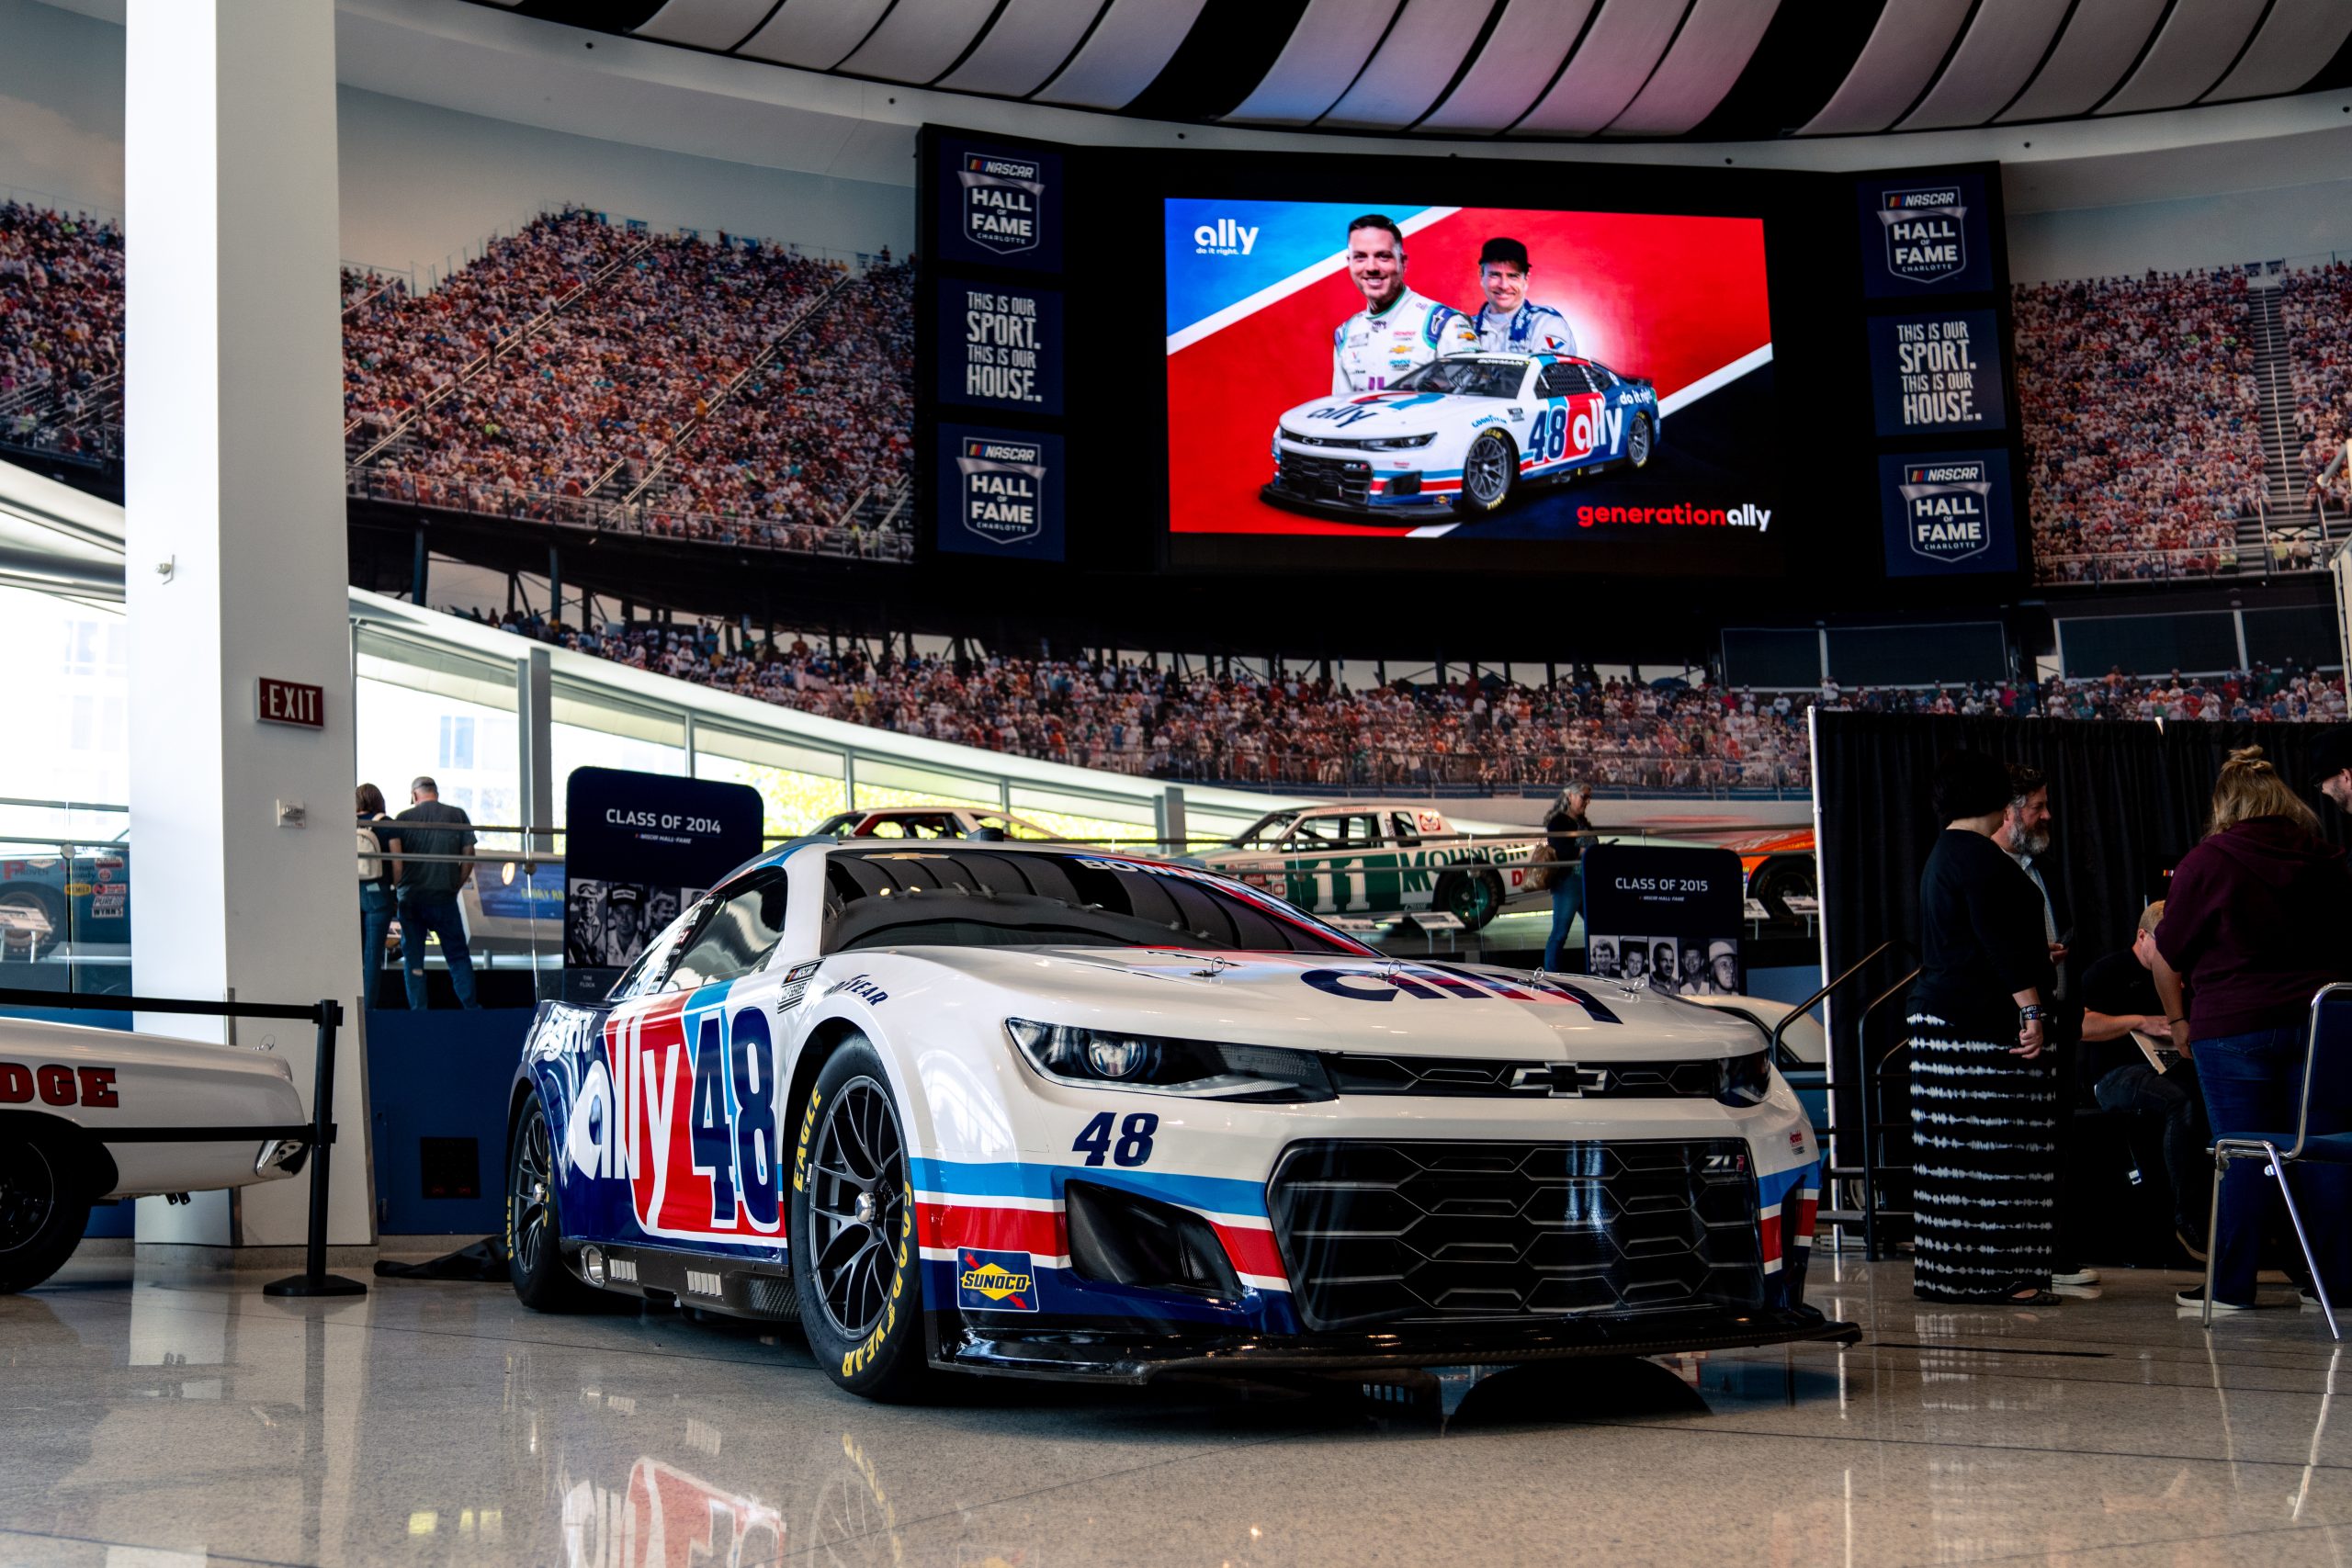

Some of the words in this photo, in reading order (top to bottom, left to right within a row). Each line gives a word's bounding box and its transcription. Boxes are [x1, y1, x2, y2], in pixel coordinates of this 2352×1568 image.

[985, 161, 1035, 178] NASCAR
[972, 187, 1033, 212] HALL
[1905, 192, 1955, 207] NASCAR
[971, 213, 1033, 238] FAME
[1194, 219, 1260, 255] ally
[1894, 220, 1956, 241] HALL
[977, 232, 1026, 245] CHARLOTTE
[1894, 244, 1959, 265] FAME
[1902, 263, 1952, 273] CHARLOTTE
[967, 291, 994, 311] THIS
[997, 295, 1010, 313] IS
[1011, 297, 1037, 317] OUR
[967, 310, 1042, 350] SPORT.
[1896, 323, 1925, 343] THIS
[1928, 322, 1940, 340] IS
[1942, 321, 1970, 339] OUR
[967, 344, 994, 364] THIS
[997, 347, 1010, 366] IS
[1011, 349, 1037, 369] OUR
[1898, 338, 1977, 374] SPORT.
[967, 363, 1043, 402] HOUSE.
[1901, 374, 1929, 393] THIS
[1932, 373, 1945, 390] IS
[1947, 371, 1974, 389] OUR
[1306, 404, 1378, 428] ally
[1903, 389, 1983, 425] HOUSE.
[1527, 405, 1568, 465] 48
[1572, 398, 1623, 456] ally
[985, 445, 1036, 462] NASCAR
[971, 474, 1035, 498] HALL
[1928, 467, 1979, 481] NASCAR
[971, 500, 1035, 525] FAME
[1916, 497, 1980, 517] HALL
[977, 521, 1027, 533] CHARLOTTE
[1917, 521, 1982, 542] FAME
[1924, 541, 1976, 550] CHARLOTTE
[268, 683, 317, 722] EXIT
[605, 808, 657, 828] CLASS
[661, 814, 682, 829] OF
[685, 816, 722, 834] 2014
[1312, 857, 1371, 913] 11
[1615, 877, 1656, 890] CLASS
[1659, 878, 1676, 891] OF
[1679, 879, 1708, 892] 2015
[570, 1015, 681, 1230] ally
[691, 1006, 781, 1233] 48
[793, 1081, 822, 1192] EAGLE
[1071, 1111, 1159, 1167] 48
[1702, 1155, 1745, 1174] ZL1
[842, 1180, 912, 1378] GOODYEAR
[964, 1273, 1027, 1292] SUNOCO
